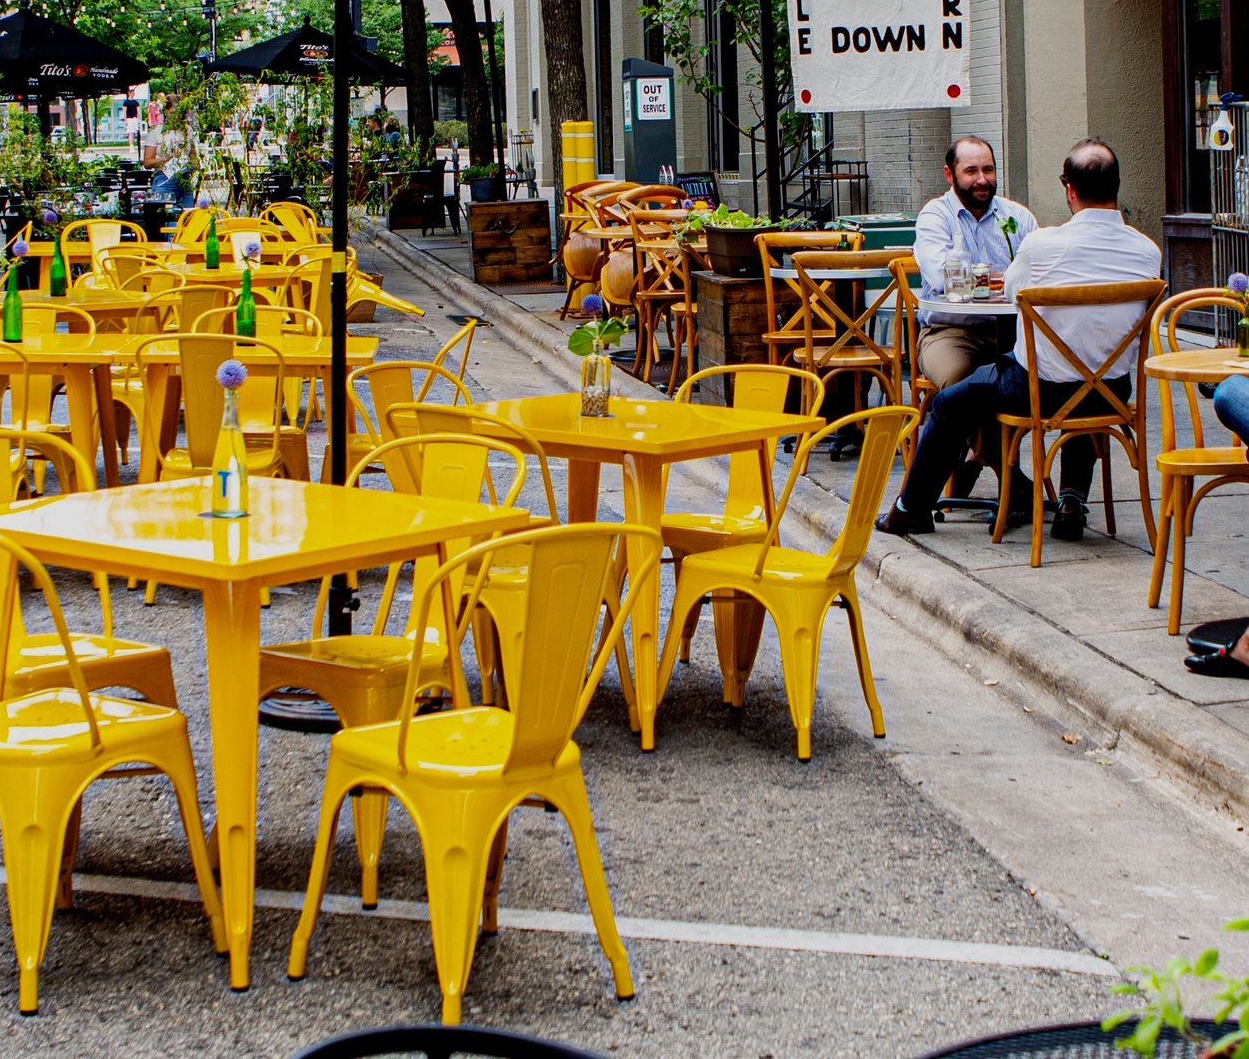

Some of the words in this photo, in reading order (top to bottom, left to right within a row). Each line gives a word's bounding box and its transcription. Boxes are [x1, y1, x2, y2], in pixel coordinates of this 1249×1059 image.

[831, 24, 926, 54] DOWN
[40, 63, 72, 76] Tito's
[643, 85, 662, 94] OUT
[642, 104, 666, 113] SERVICE
